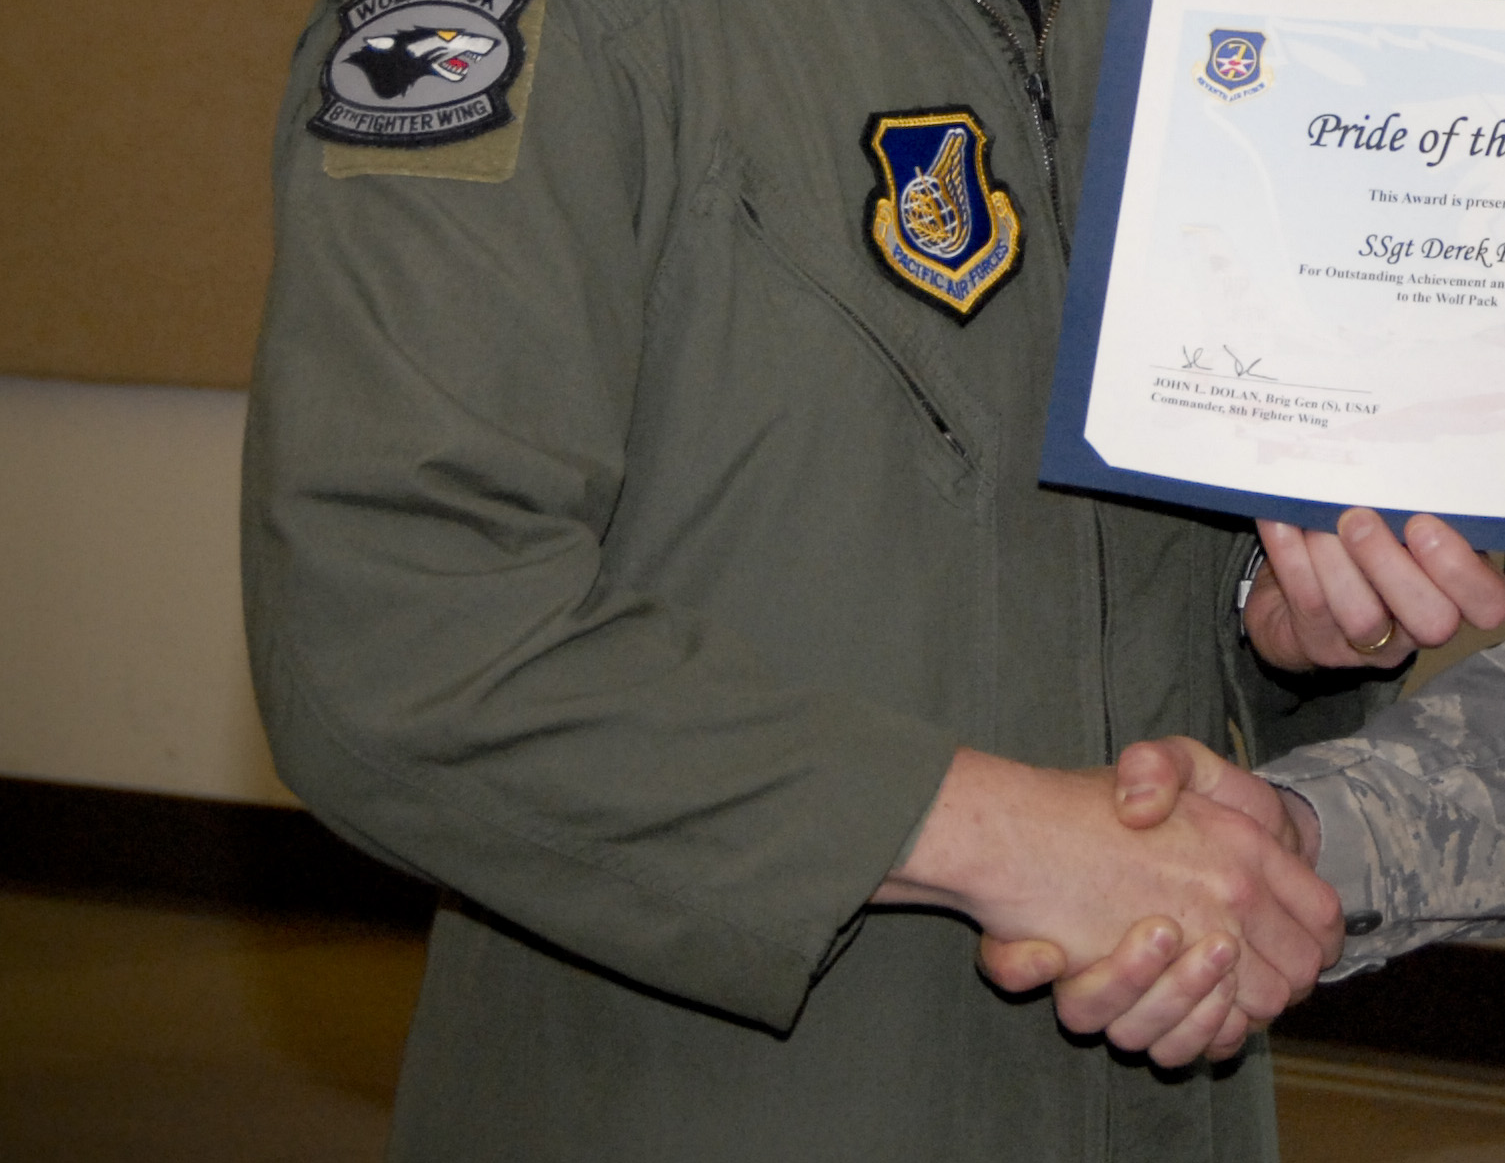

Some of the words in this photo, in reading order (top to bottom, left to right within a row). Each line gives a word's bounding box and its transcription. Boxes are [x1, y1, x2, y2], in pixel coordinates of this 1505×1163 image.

[357, 112, 433, 133] FIGHTER
[438, 100, 488, 126] WING
[1308, 112, 1408, 152] Pride
[1418, 116, 1468, 167] of
[1369, 189, 1398, 203] This
[1402, 192, 1448, 206] Award
[1452, 194, 1462, 207] is
[1358, 234, 1415, 265] SSgt
[1421, 237, 1493, 268] Derek
[893, 244, 944, 288] PACIFIC
[946, 279, 969, 301] AIR
[969, 239, 1009, 287] FORCES
[1299, 263, 1322, 276] For
[1325, 266, 1404, 285] Outstanding
[1407, 273, 1486, 288] Achievement
[1396, 291, 1408, 302] to
[1413, 292, 1432, 303] the
[1435, 292, 1466, 306] Wolf
[1468, 294, 1498, 307] Pack
[1151, 392, 1226, 414] Commander,
[1229, 404, 1248, 416] 8th
[1252, 407, 1294, 422] Fighter
[1298, 413, 1329, 428] Wing
[1153, 377, 1191, 392] JOHN
[1195, 383, 1206, 395] L.
[1210, 385, 1262, 403] DOLAN,
[1265, 393, 1291, 408] Brig
[1295, 396, 1318, 409] Gen
[1345, 402, 1380, 415] USAF
